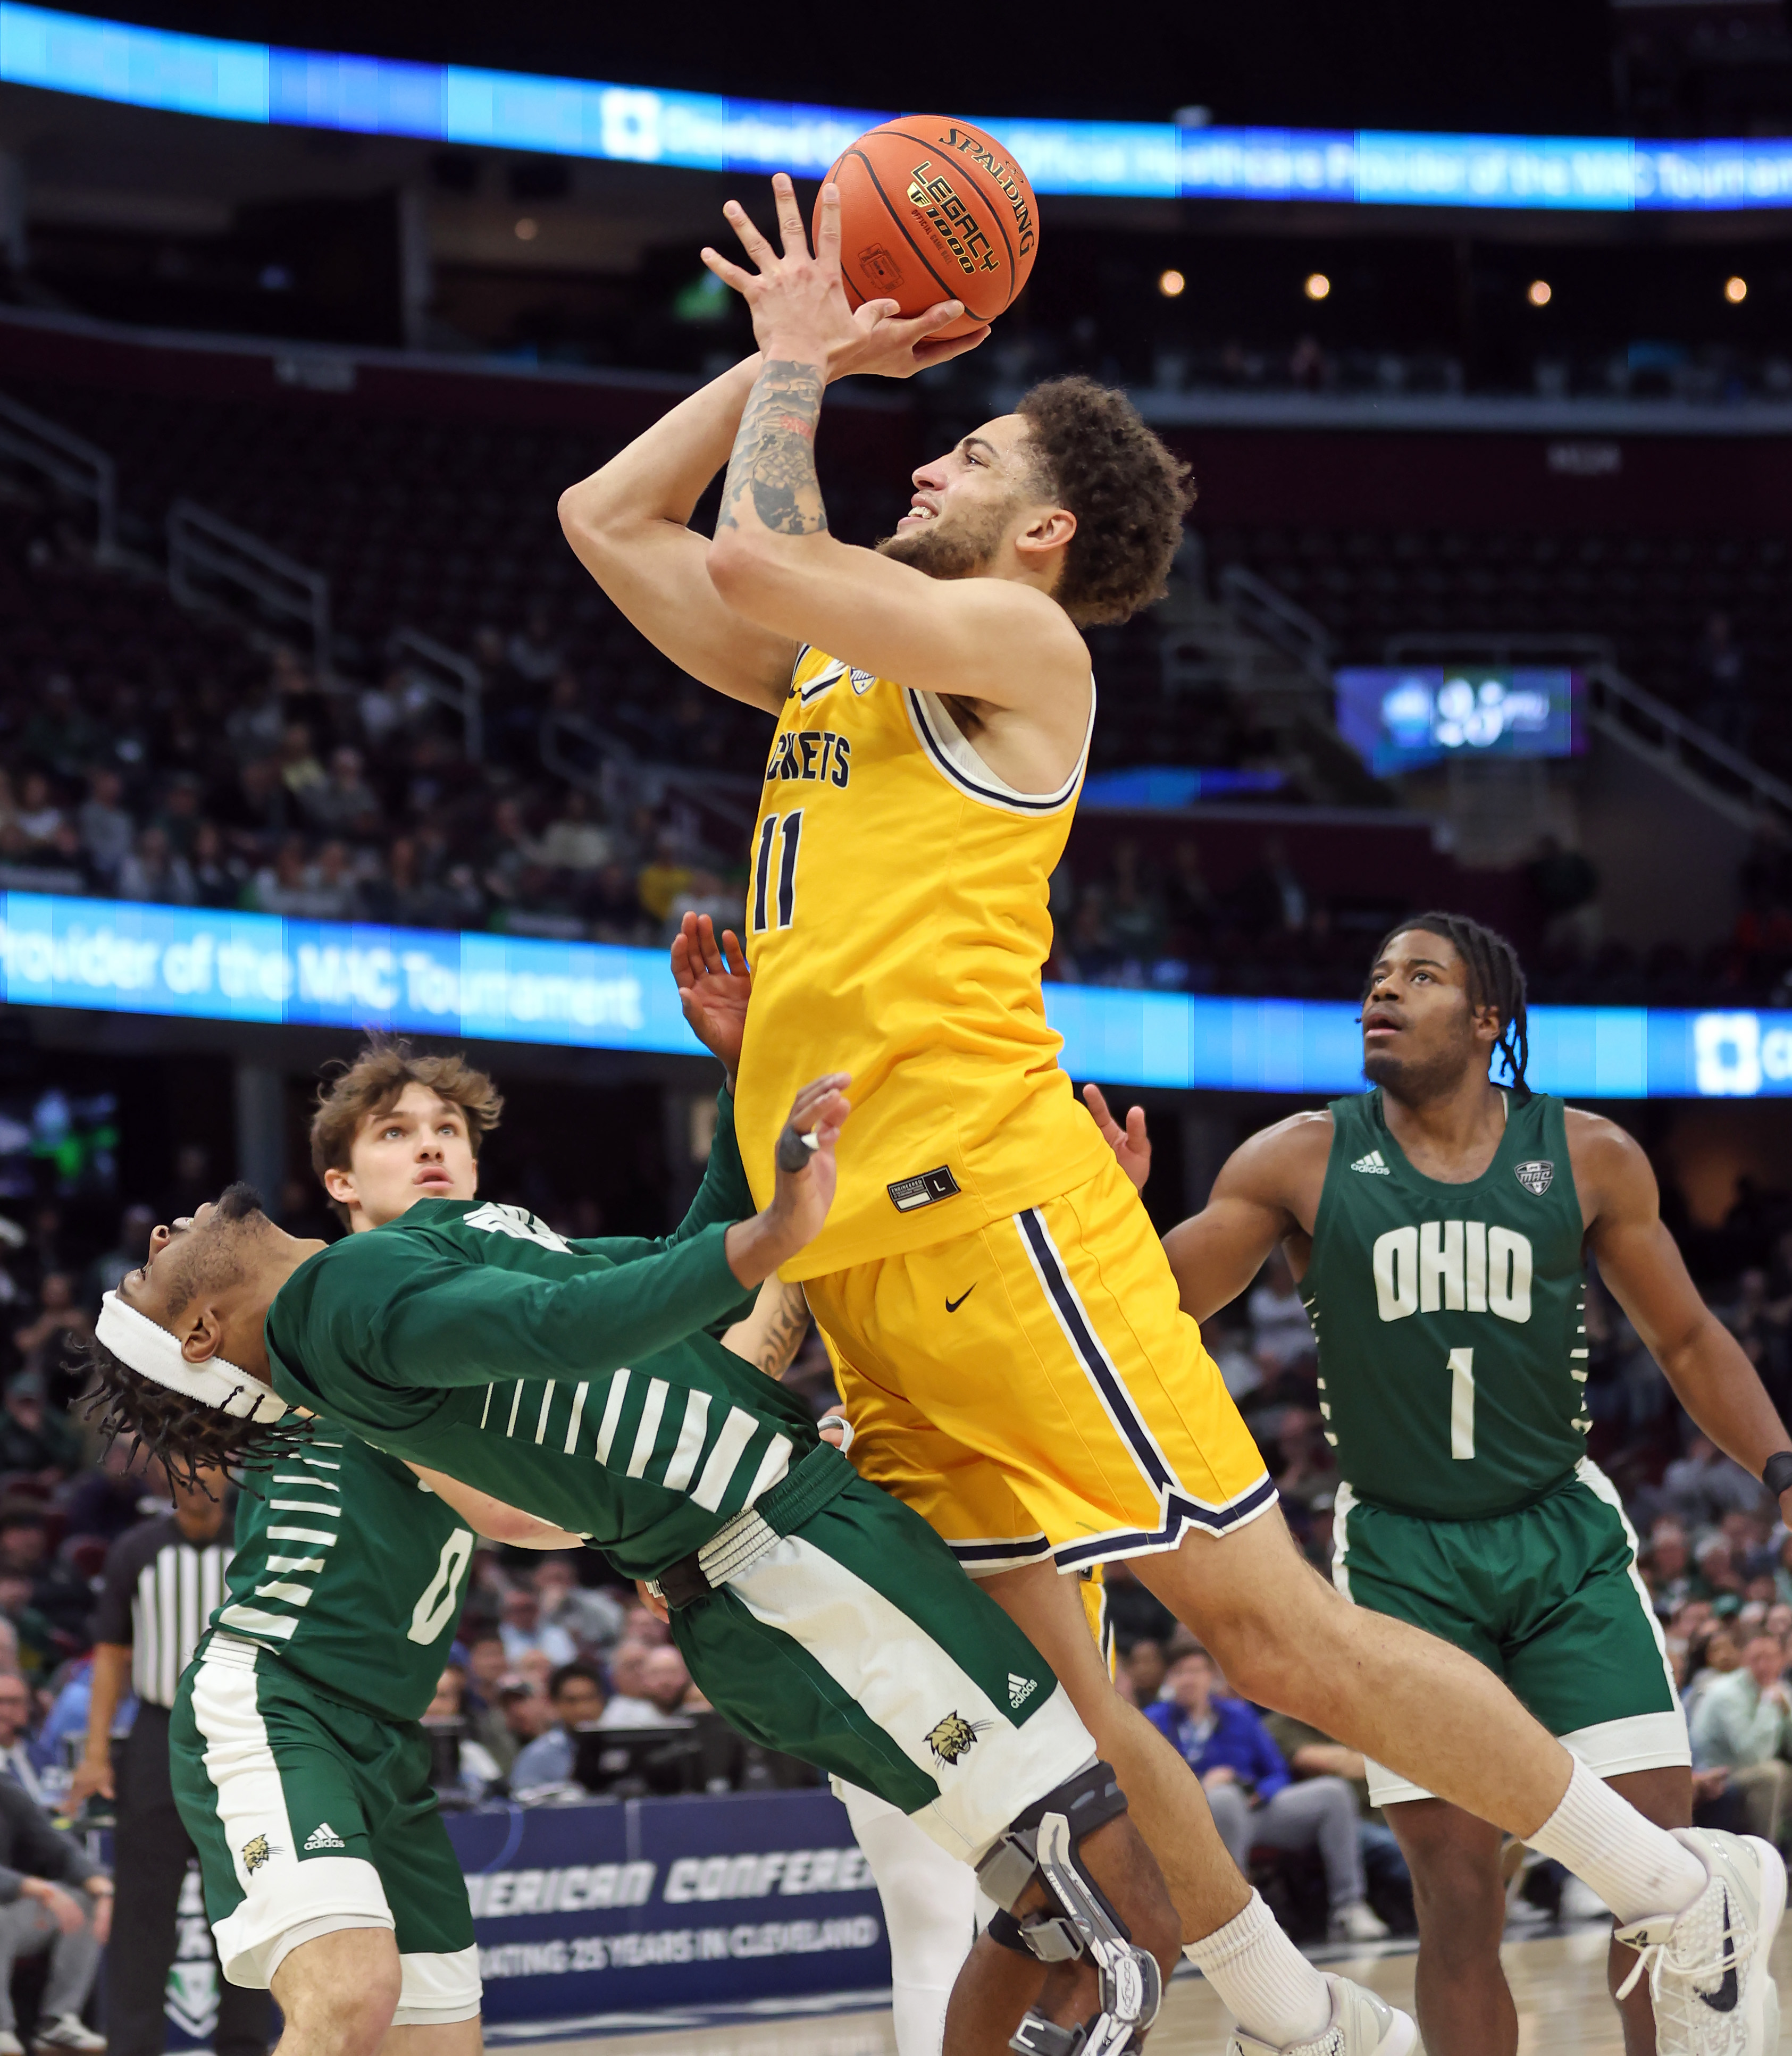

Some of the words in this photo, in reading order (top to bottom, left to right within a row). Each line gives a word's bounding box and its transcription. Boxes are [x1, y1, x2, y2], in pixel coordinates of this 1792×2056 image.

[910, 161, 1000, 273] LEGACY
[911, 209, 933, 236] OFFICIAL
[930, 234, 943, 251] GAME
[938, 128, 1035, 257] SPALDING
[752, 807, 805, 935] 11
[0, 918, 156, 992] rovider
[162, 933, 215, 995] of
[217, 937, 291, 1003] the
[297, 944, 401, 1011] MAC
[402, 950, 644, 1031] Tournament
[933, 1179, 946, 1192] L
[1351, 1162, 1390, 1176] adidas
[1520, 1171, 1553, 1183] MAC
[1372, 1220, 1533, 1324] OHIO
[1446, 1347, 1476, 1460] 1
[406, 1527, 474, 1646] 0
[1010, 1679, 1038, 1709] adidas
[303, 1838, 346, 1851] adidas
[608, 1927, 692, 1969] YEARS
[693, 1926, 728, 1960] IN
[729, 1915, 881, 1959] CLEVELAND
